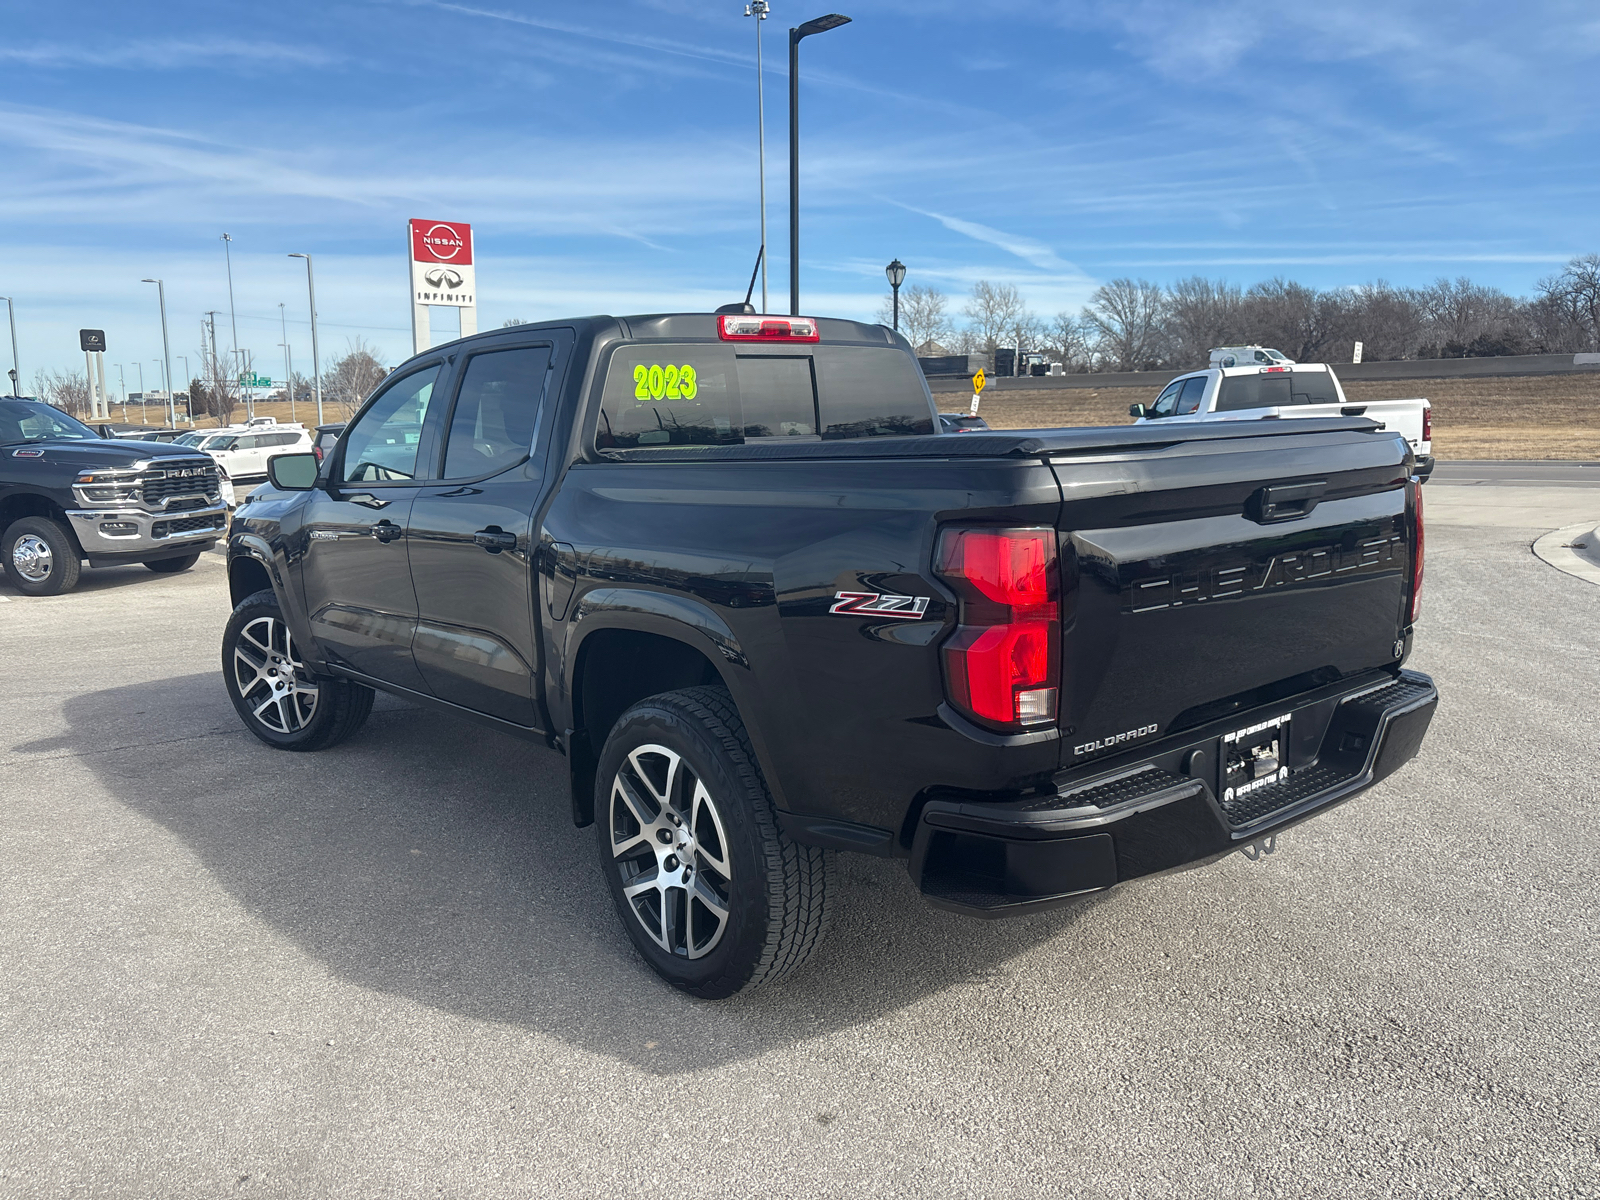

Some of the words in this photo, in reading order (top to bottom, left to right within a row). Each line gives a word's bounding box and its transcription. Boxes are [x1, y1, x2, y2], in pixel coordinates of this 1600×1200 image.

[423, 236, 463, 247] NISSAN
[417, 292, 473, 303] INFINITI
[633, 363, 698, 401] 2023
[167, 467, 207, 478] RAM
[1130, 536, 1400, 613] CHEVROLET
[828, 590, 931, 620] Z71
[1073, 723, 1159, 756] COLORADO
